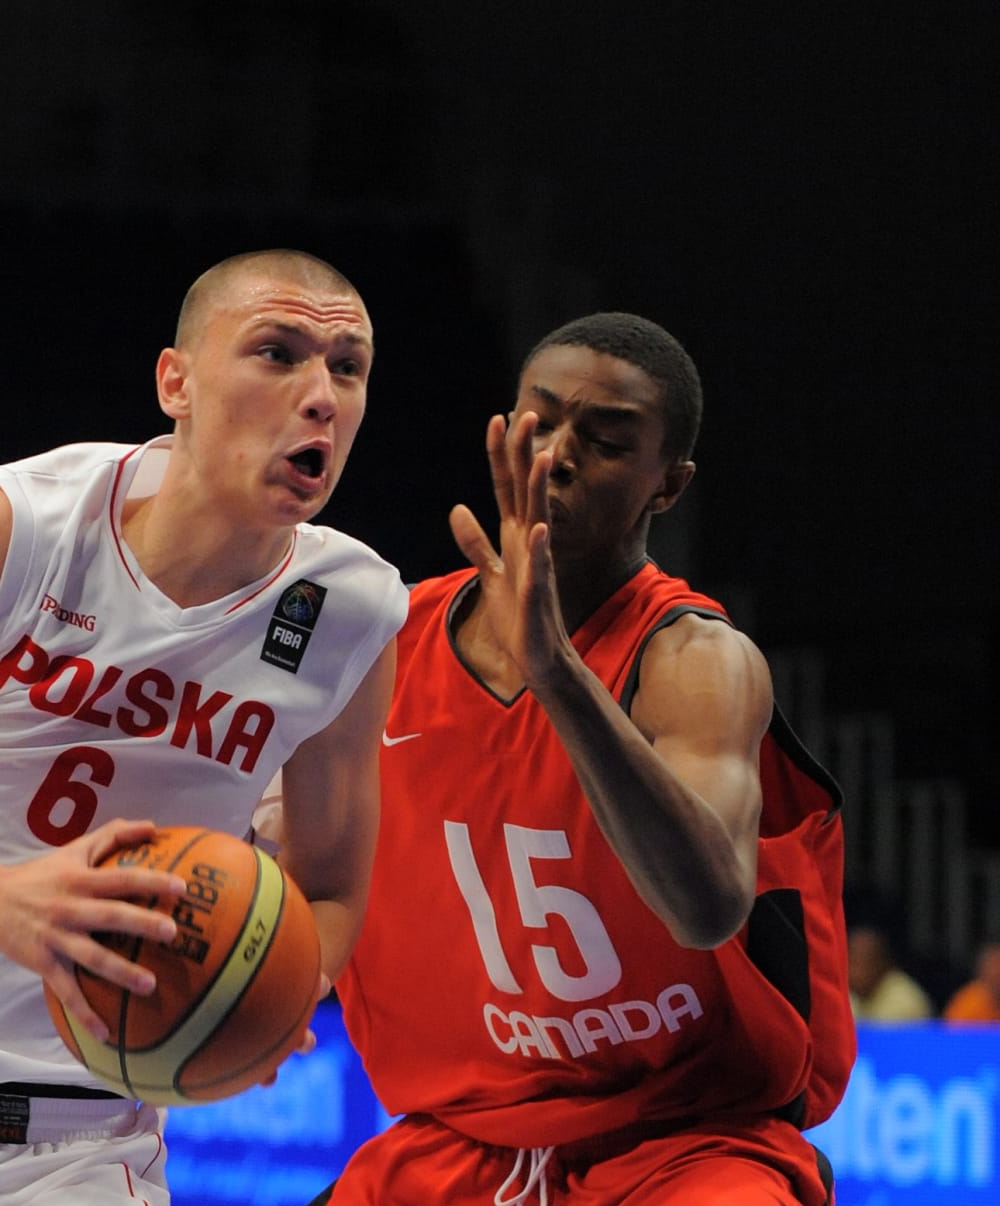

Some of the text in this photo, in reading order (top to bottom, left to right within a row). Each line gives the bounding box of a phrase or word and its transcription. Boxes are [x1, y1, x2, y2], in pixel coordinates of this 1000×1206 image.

[271, 625, 303, 650] FIBA
[26, 745, 116, 848] 6
[171, 862, 229, 936] FIBA
[443, 819, 624, 1002] 15
[482, 982, 705, 1061] CANADA
